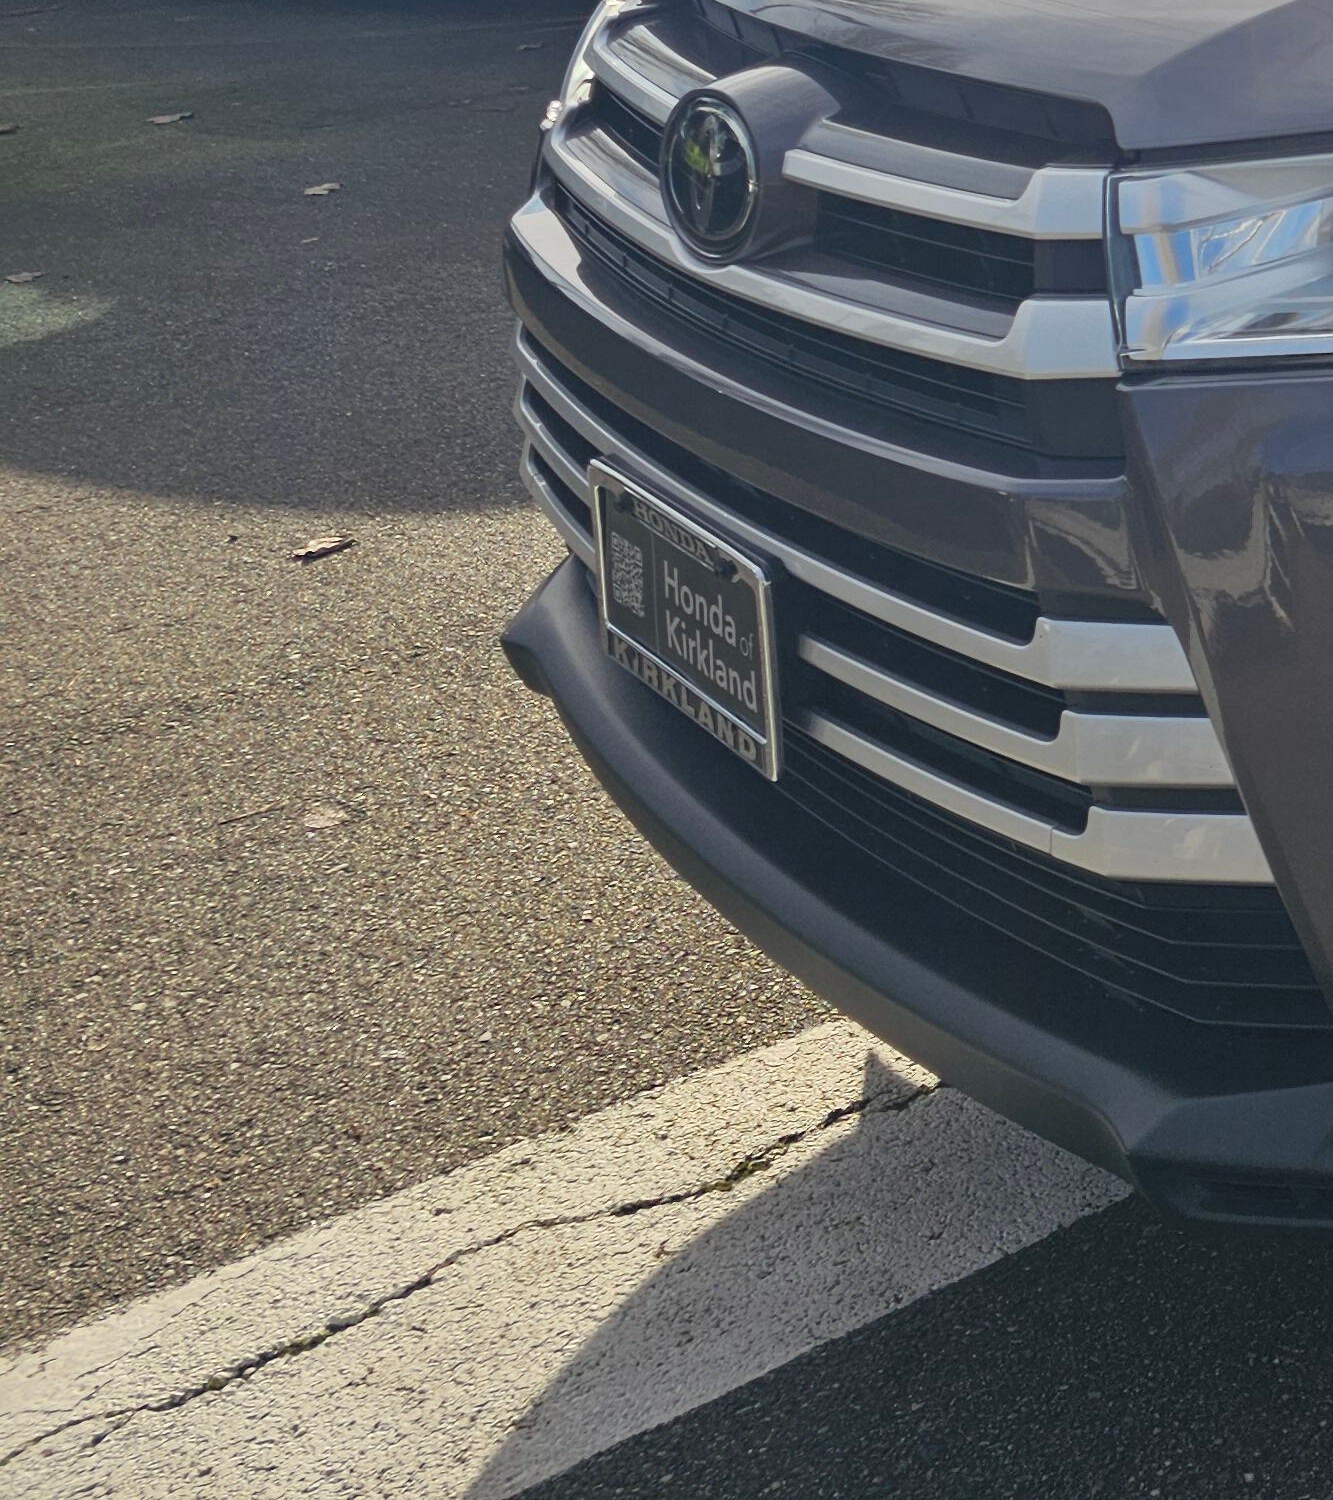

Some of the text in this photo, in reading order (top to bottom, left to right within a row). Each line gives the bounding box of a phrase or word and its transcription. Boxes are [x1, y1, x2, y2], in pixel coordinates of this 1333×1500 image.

[633, 499, 714, 567] HONDA
[662, 560, 754, 660] Honda of
[613, 638, 757, 761] KIRKLAND
[664, 610, 758, 714] Kirkland
